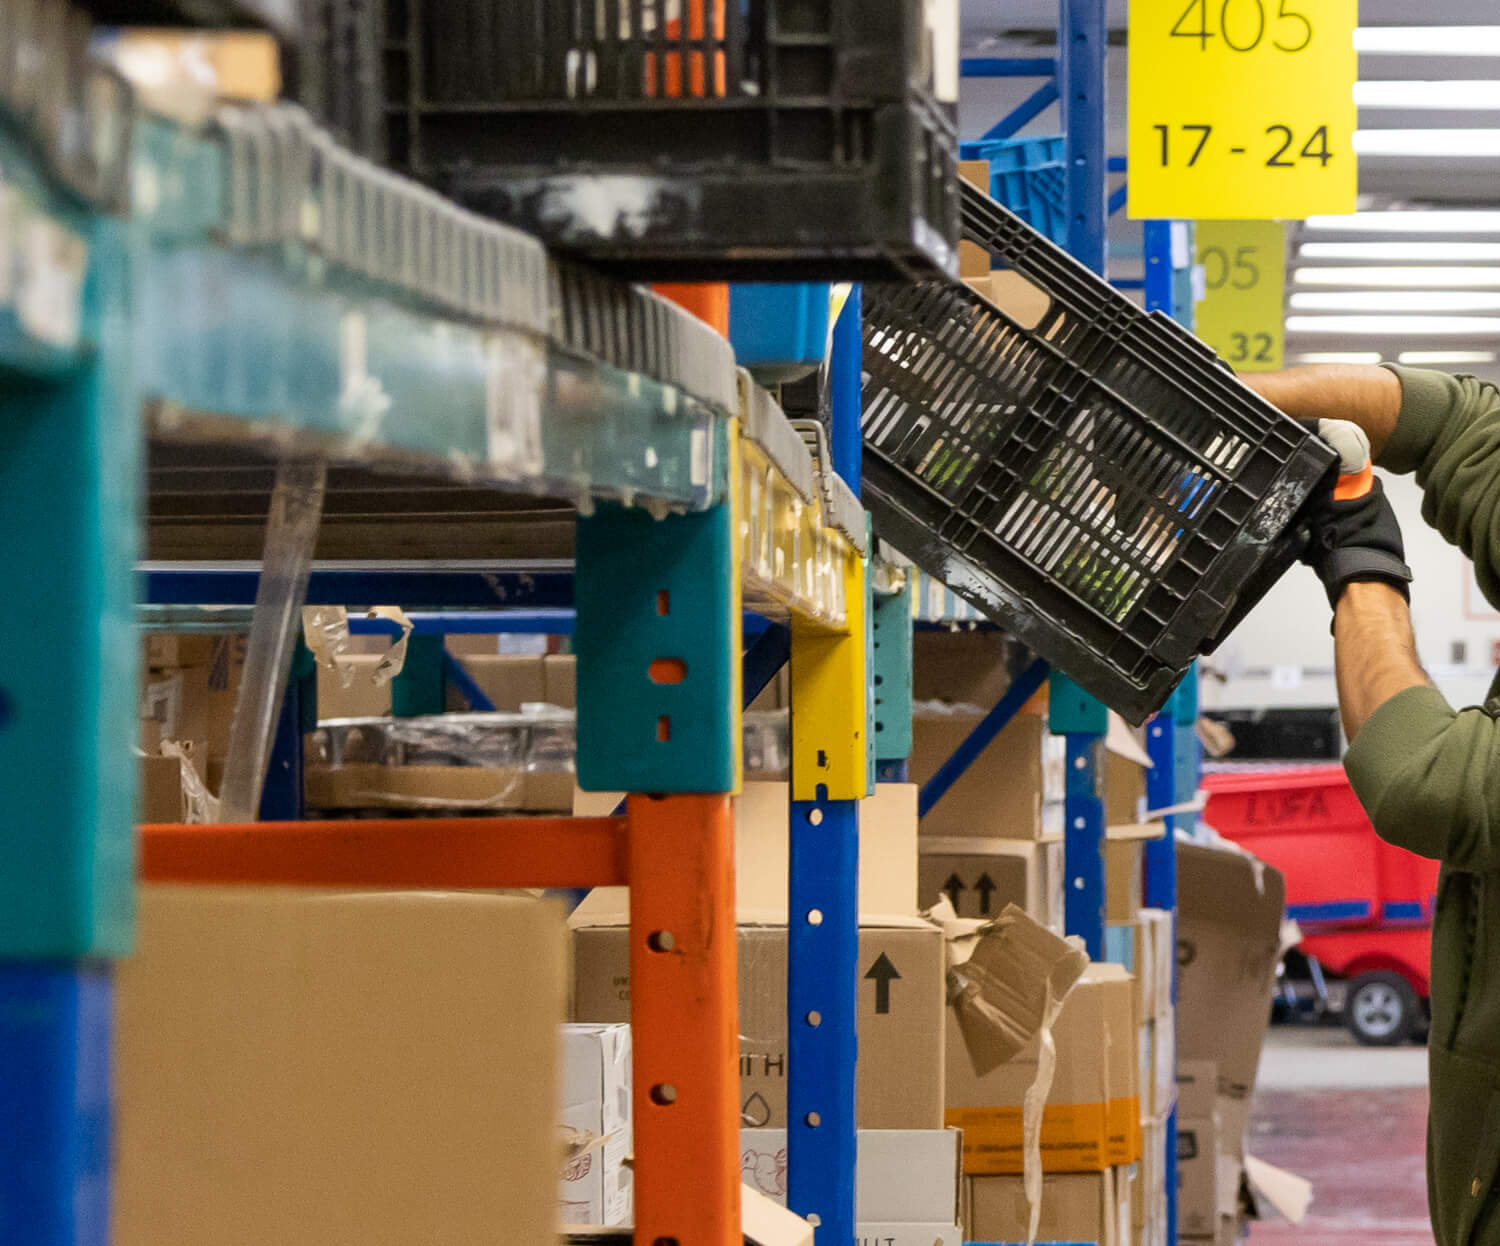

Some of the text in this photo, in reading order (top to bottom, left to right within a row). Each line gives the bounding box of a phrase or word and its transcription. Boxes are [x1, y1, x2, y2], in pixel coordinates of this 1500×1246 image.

[1169, 0, 1312, 52] 405
[1153, 124, 1213, 167] 17
[1265, 125, 1333, 167] 24
[1198, 245, 1260, 290] 05
[1229, 332, 1273, 362] 32
